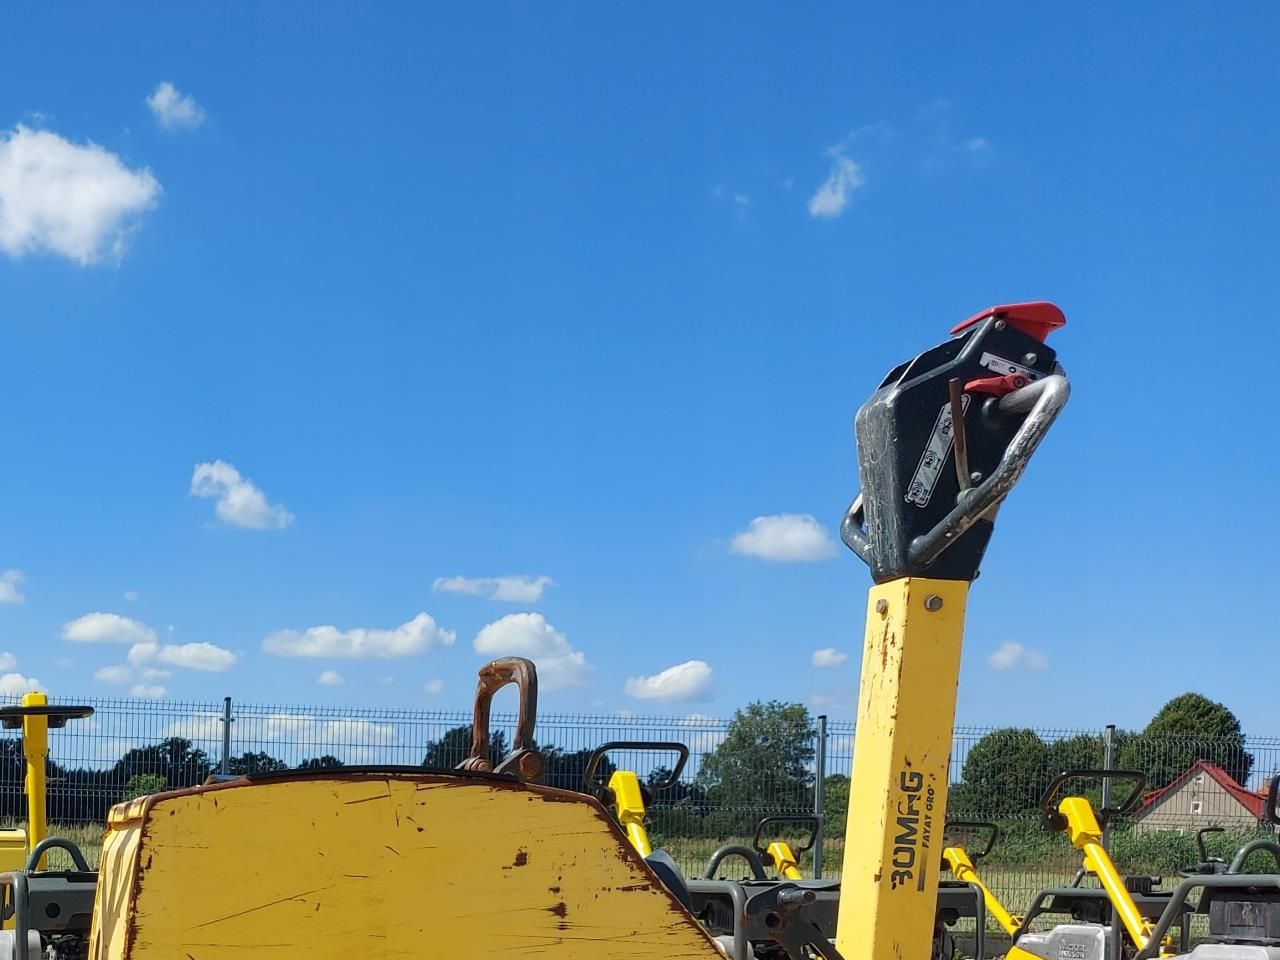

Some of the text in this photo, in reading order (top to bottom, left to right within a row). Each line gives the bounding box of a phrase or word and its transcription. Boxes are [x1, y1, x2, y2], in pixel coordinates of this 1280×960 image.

[922, 773, 936, 848] FAYAT GRO
[1058, 950, 1085, 959] NEUSON
